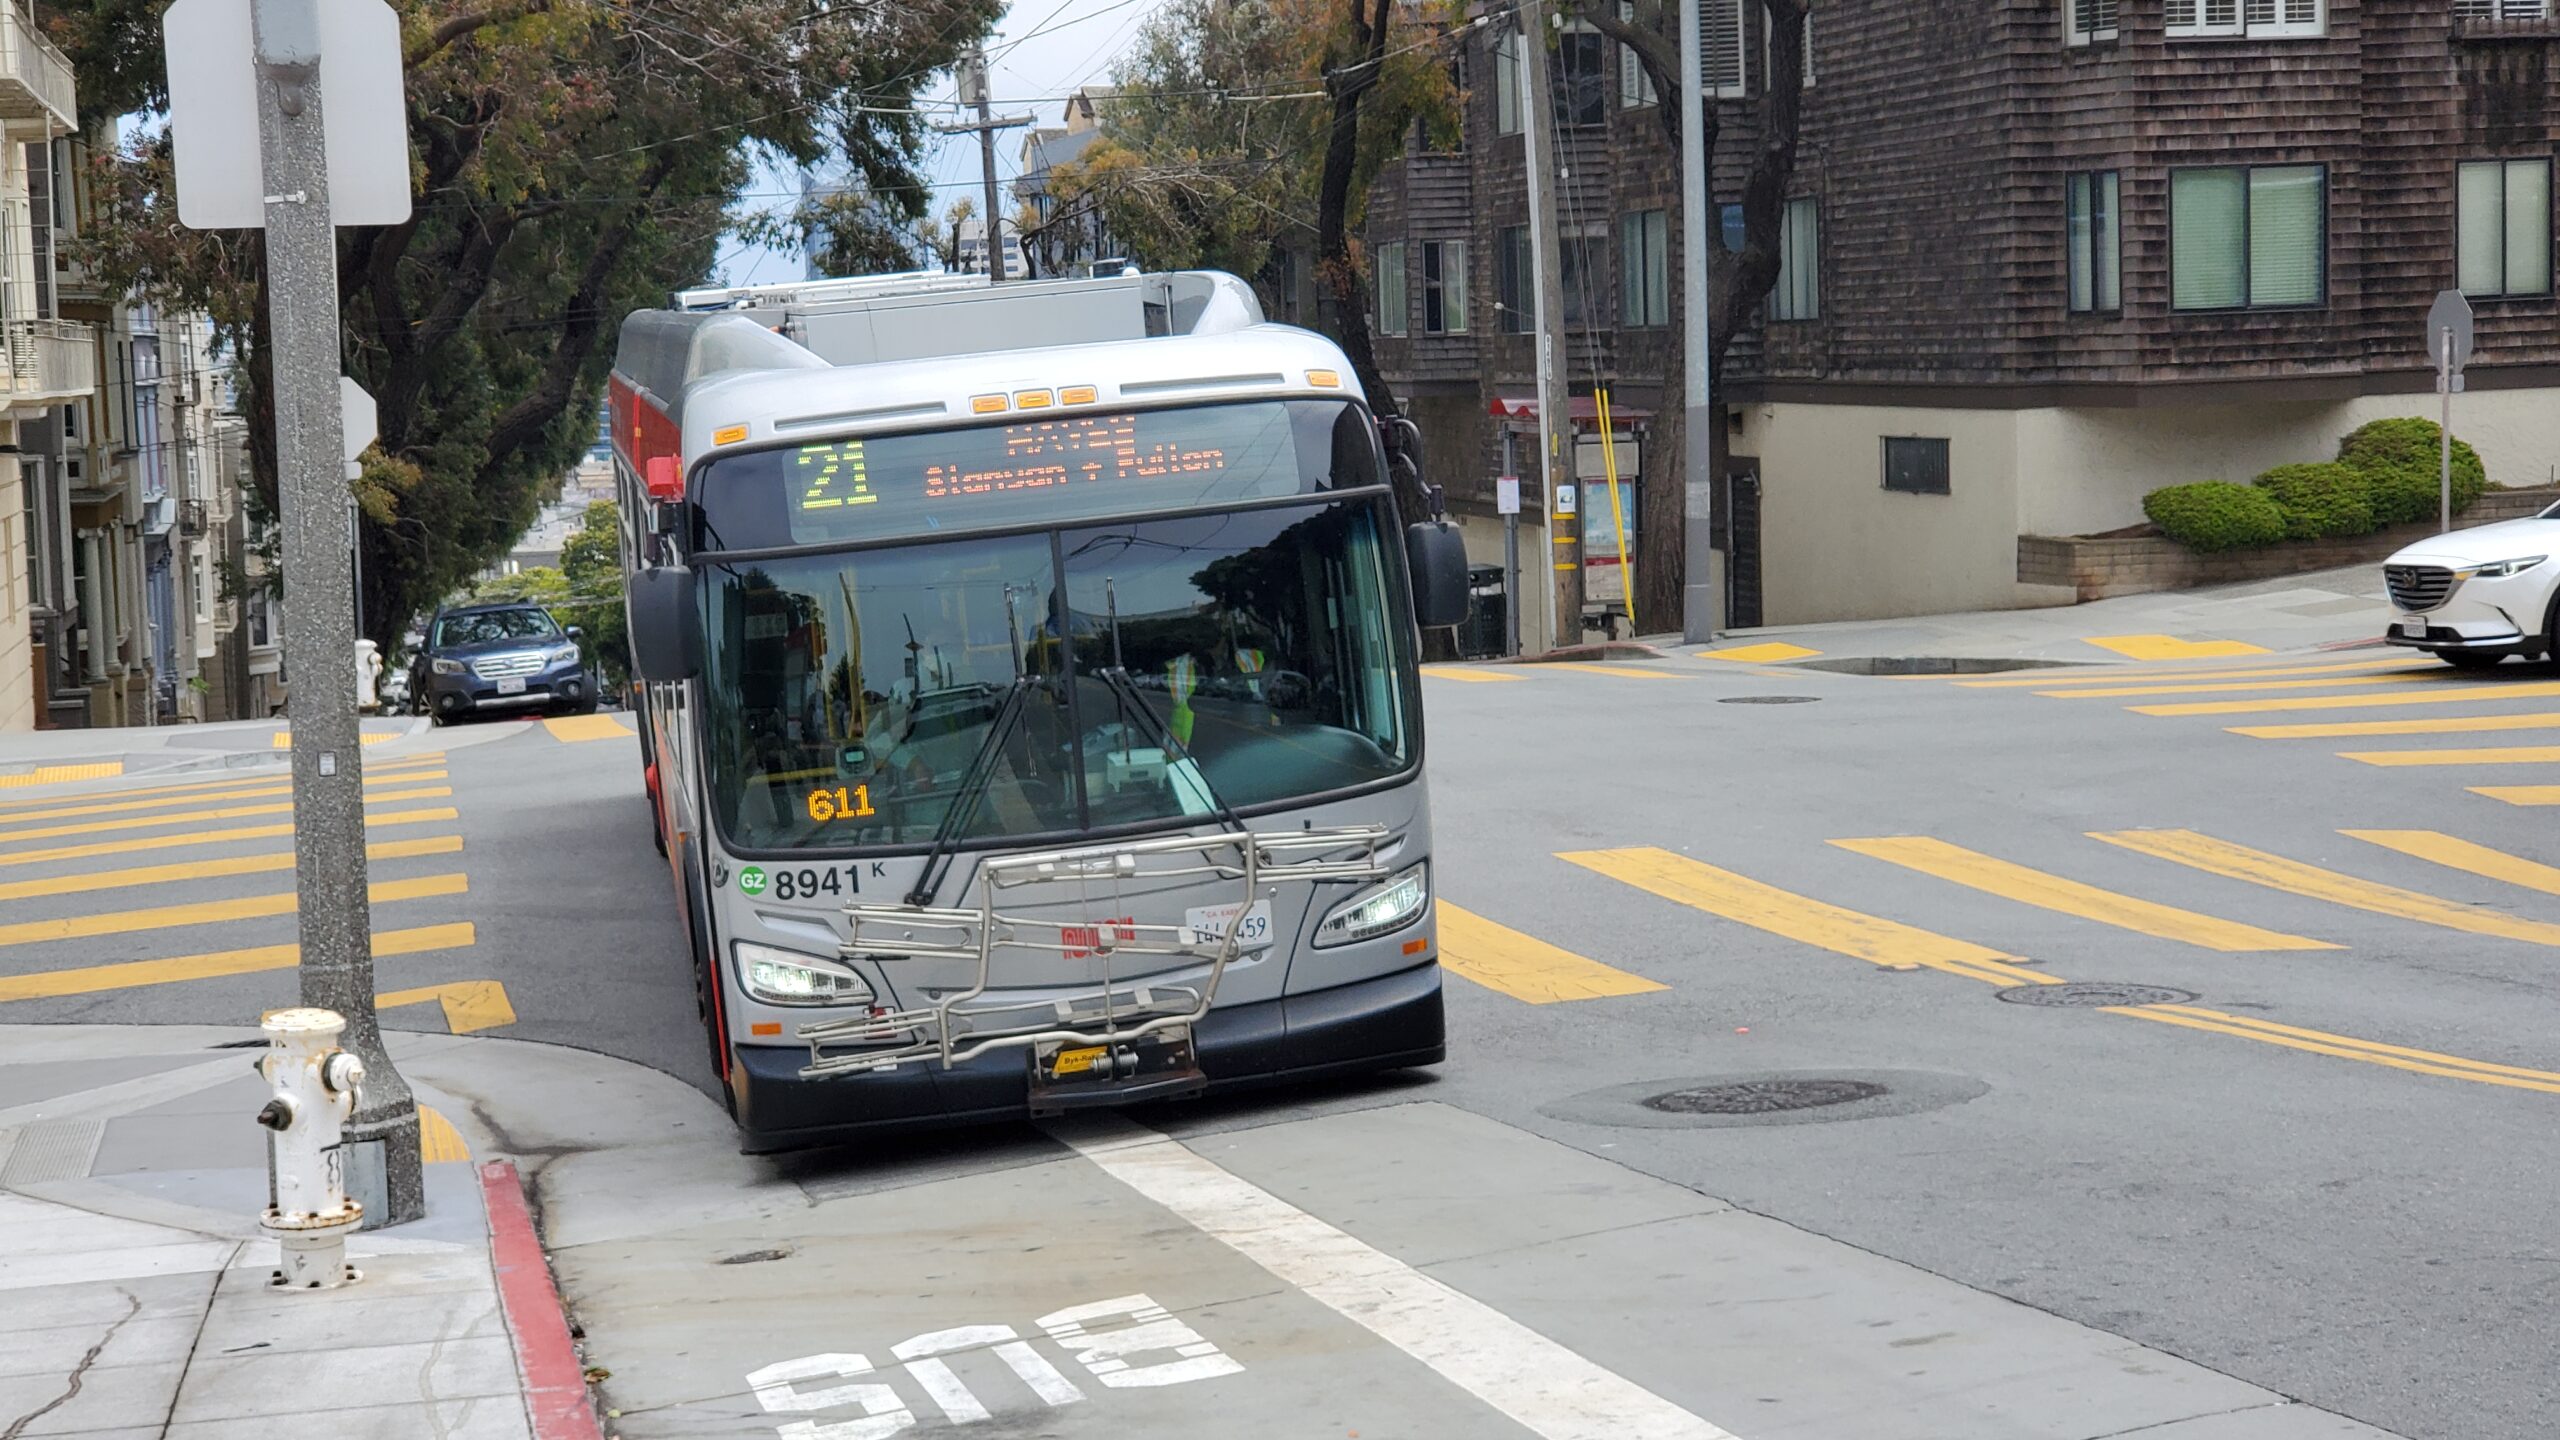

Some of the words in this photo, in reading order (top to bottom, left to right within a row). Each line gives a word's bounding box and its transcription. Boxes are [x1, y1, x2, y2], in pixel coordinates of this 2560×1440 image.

[797, 440, 878, 509] 21
[925, 461, 1067, 497] Stanyan
[1116, 442, 1224, 477] Fulton
[808, 784, 875, 821] 611
[741, 872, 766, 888] GZ
[775, 864, 860, 900] 8941
[871, 862, 886, 877] K
[1194, 916, 1266, 944] 144459
[745, 1293, 1247, 1440] BUS
